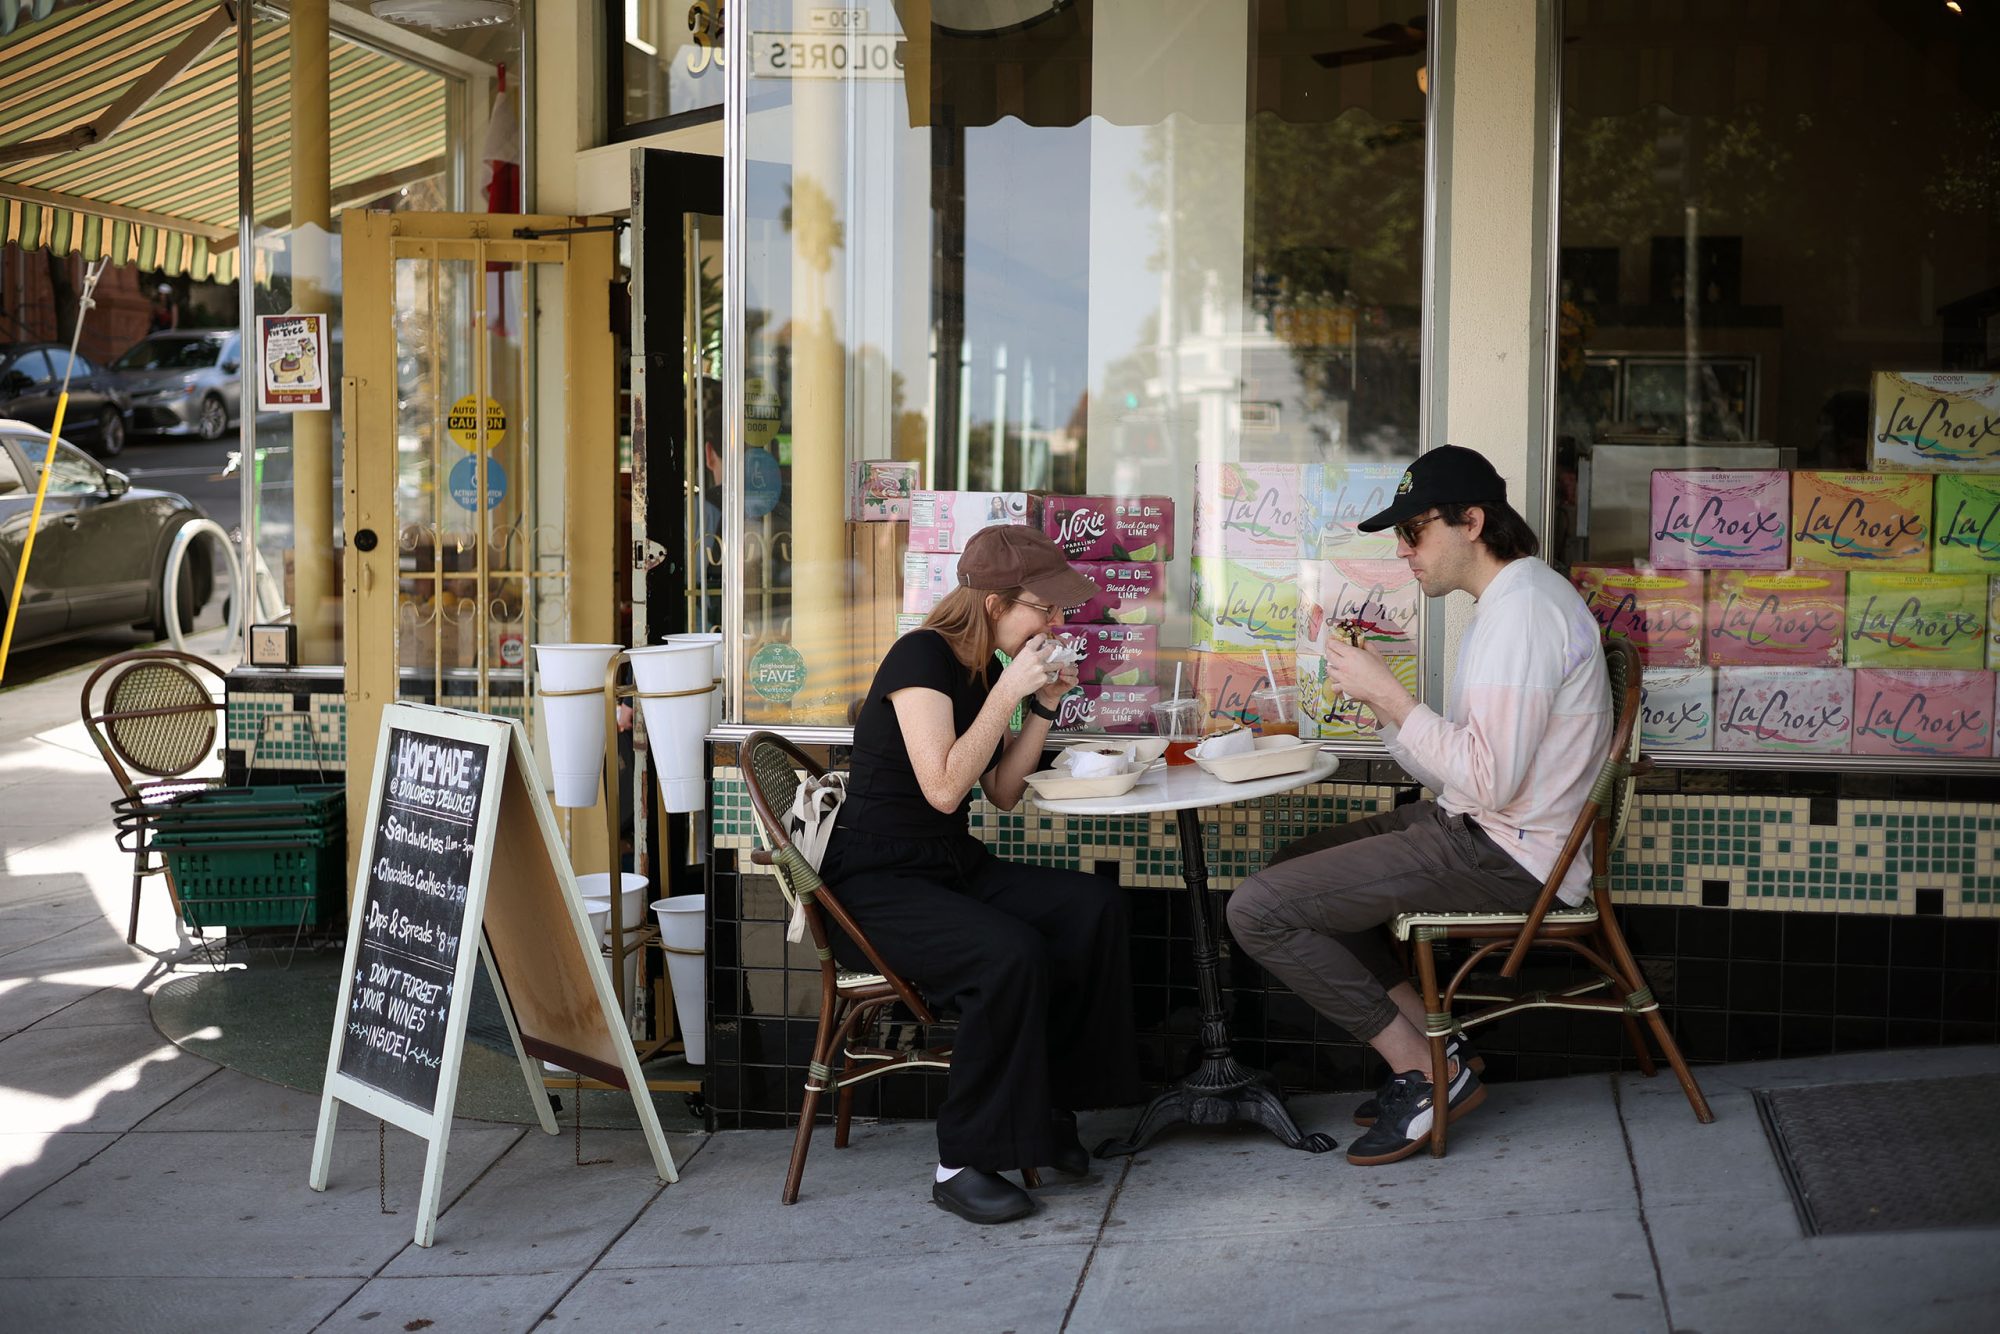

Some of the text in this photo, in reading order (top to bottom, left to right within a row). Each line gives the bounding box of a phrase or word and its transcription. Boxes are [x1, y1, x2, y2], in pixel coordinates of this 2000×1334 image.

[450, 418, 503, 429] CAUON
[453, 406, 501, 415] AUTOTIC
[465, 432, 489, 440] DO
[1054, 508, 1106, 544] Nixie
[1116, 520, 1160, 532] Black Cherry
[1655, 495, 1780, 547] LaCroix
[1795, 496, 1923, 549] LaCroix
[1062, 539, 1097, 550] SPARKLING
[1070, 546, 1091, 554] WATER
[1106, 584, 1150, 594] Black Cherry
[1586, 590, 1693, 642] aCroix
[1711, 593, 1837, 645] LaCroix
[1851, 595, 1979, 648] LaCroix
[1098, 645, 1143, 656] Black Cherry
[760, 669, 796, 682] FAVE
[1101, 707, 1145, 718] Black Cherry
[1720, 688, 1845, 740] LaCroix
[1856, 691, 1984, 744] LaCroix
[397, 738, 473, 789] HOMEMADE
[390, 777, 476, 817] @ DOLORES DELUXE!
[385, 815, 444, 854] Sandwiches
[378, 857, 415, 887] Chocolate
[415, 869, 446, 898] Cookies
[368, 900, 389, 937] Dips
[389, 908, 399, 939] &
[398, 916, 433, 944] Spreads
[369, 963, 442, 1004] DON'T FORGET
[360, 988, 426, 1032] YOUR WINES
[366, 1025, 411, 1063] INSIDE!
